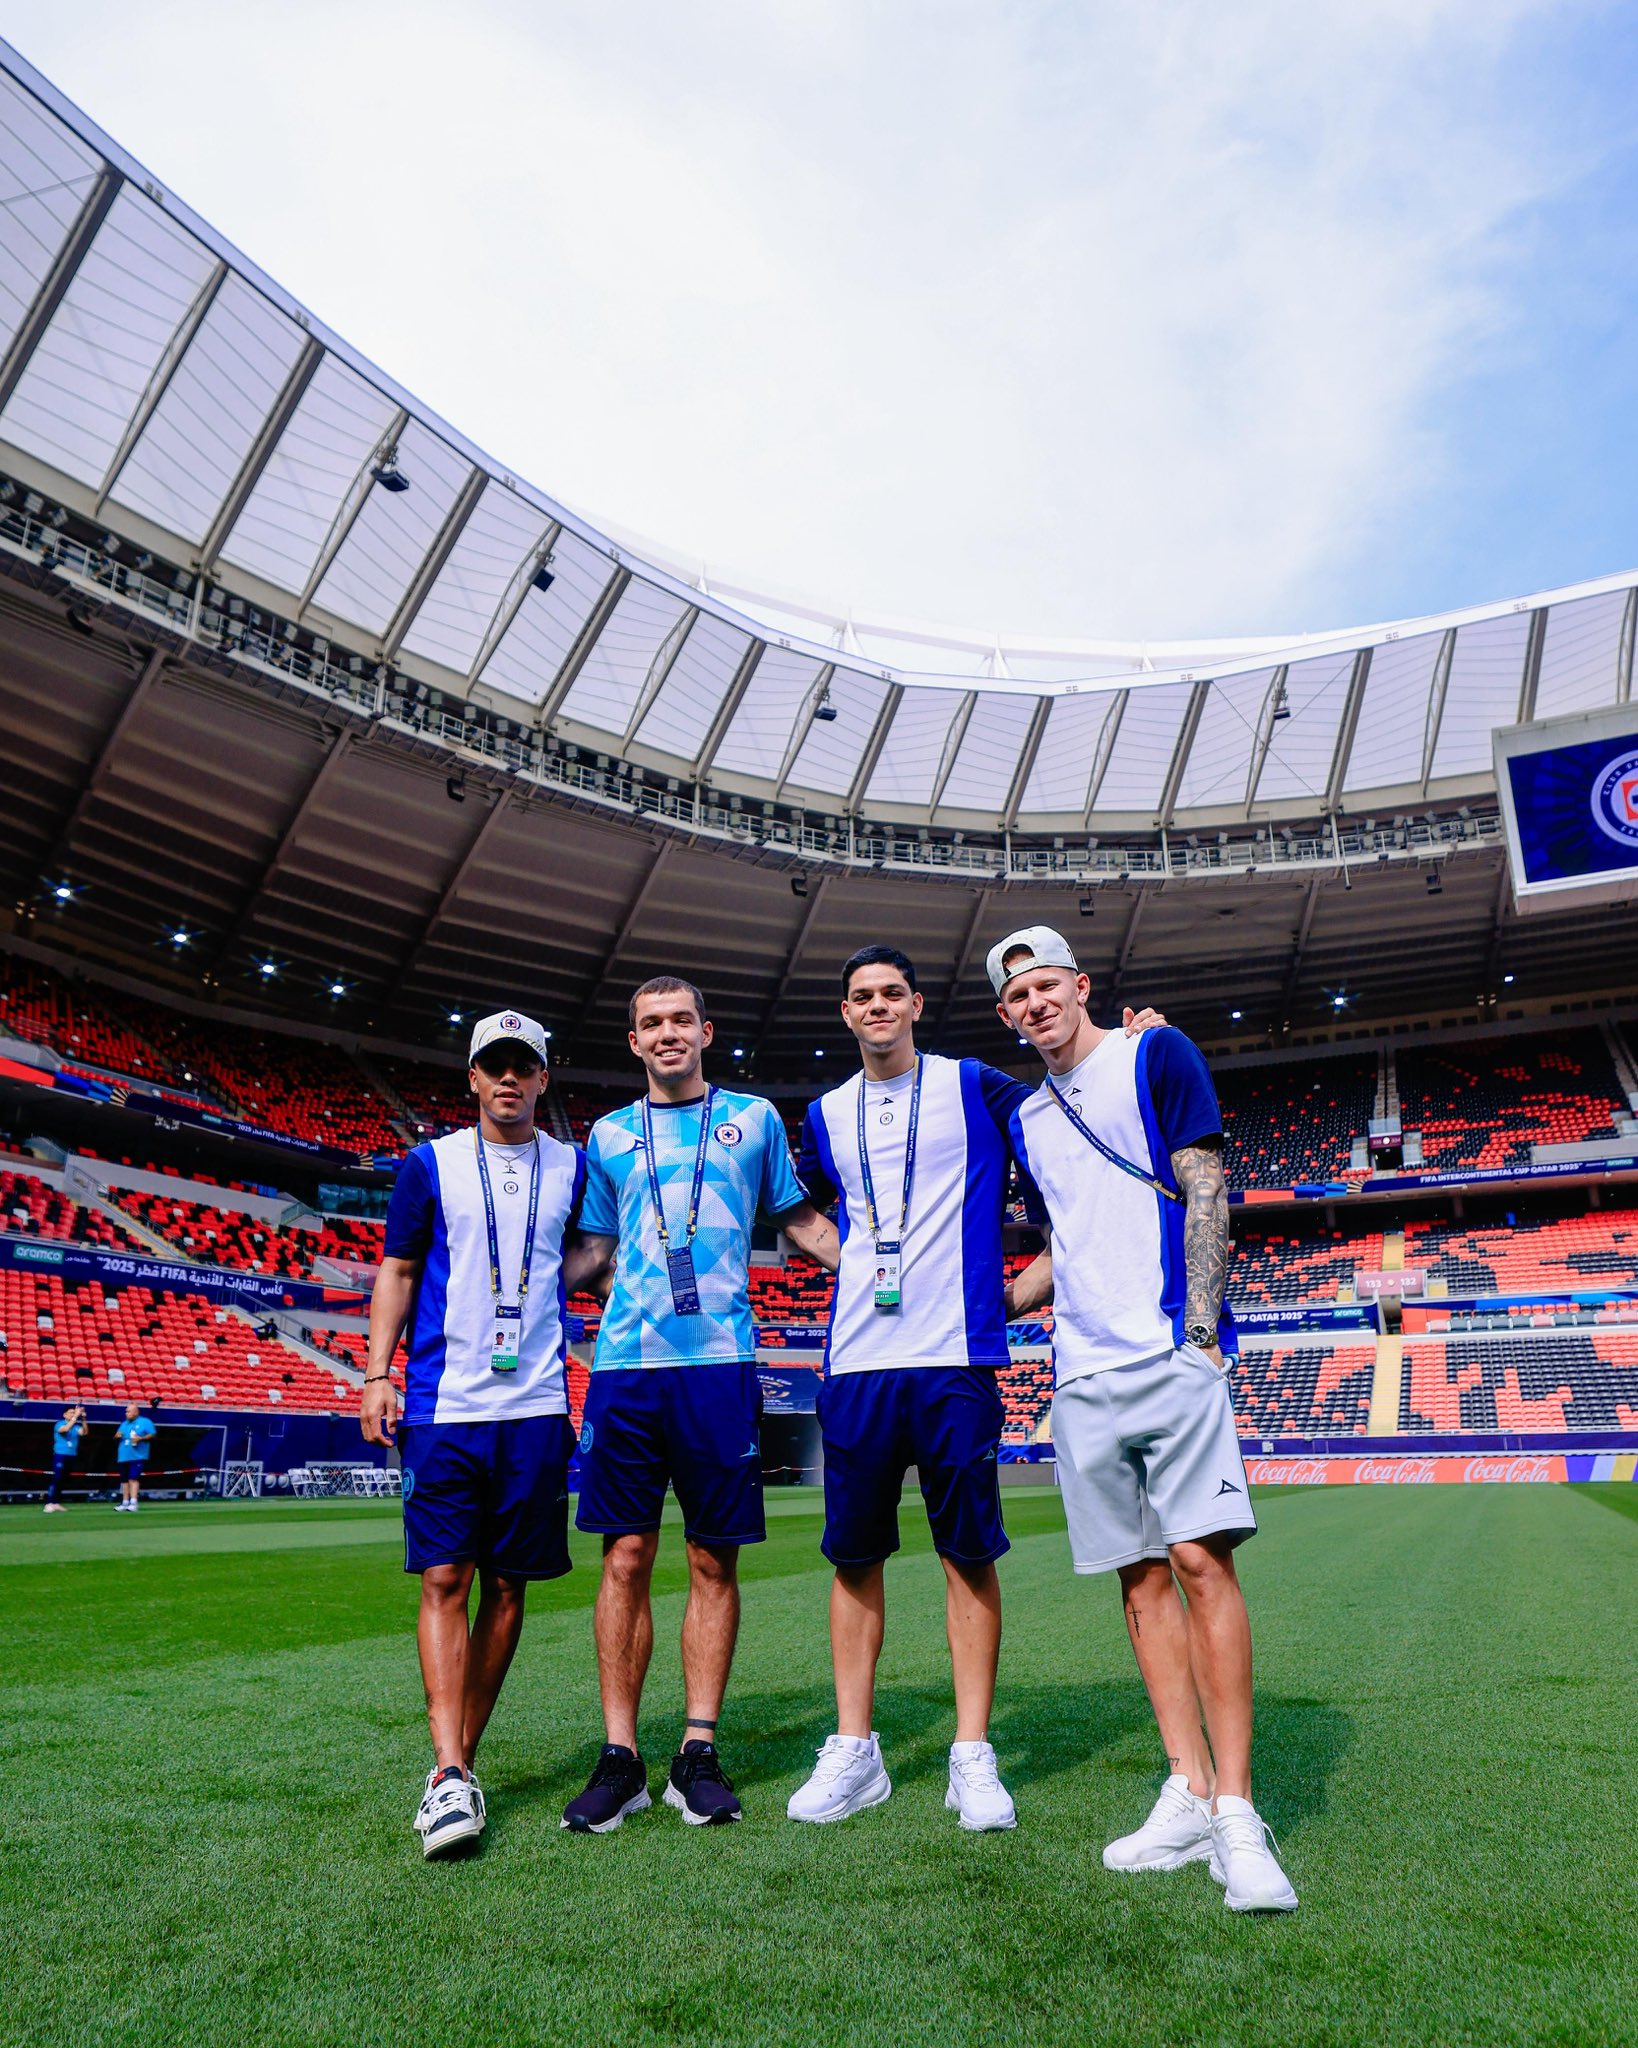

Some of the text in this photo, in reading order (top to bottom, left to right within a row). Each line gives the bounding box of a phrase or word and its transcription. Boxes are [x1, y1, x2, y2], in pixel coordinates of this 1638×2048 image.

[1420, 1175, 1437, 1183] FIFA
[1438, 1168, 1513, 1181] INTERCONTINENTAL
[1514, 1166, 1530, 1175] CUP
[1531, 1164, 1559, 1174] QATAR
[16, 1246, 62, 1261] aramco
[136, 1264, 159, 1278] قطر
[160, 1266, 187, 1281] FIFA
[189, 1271, 224, 1287] للأندية
[225, 1276, 260, 1292] القارات
[260, 1280, 284, 1295] كأس
[1249, 1313, 1280, 1322] QATAR
[785, 1329, 827, 1337] Qatar 2025
